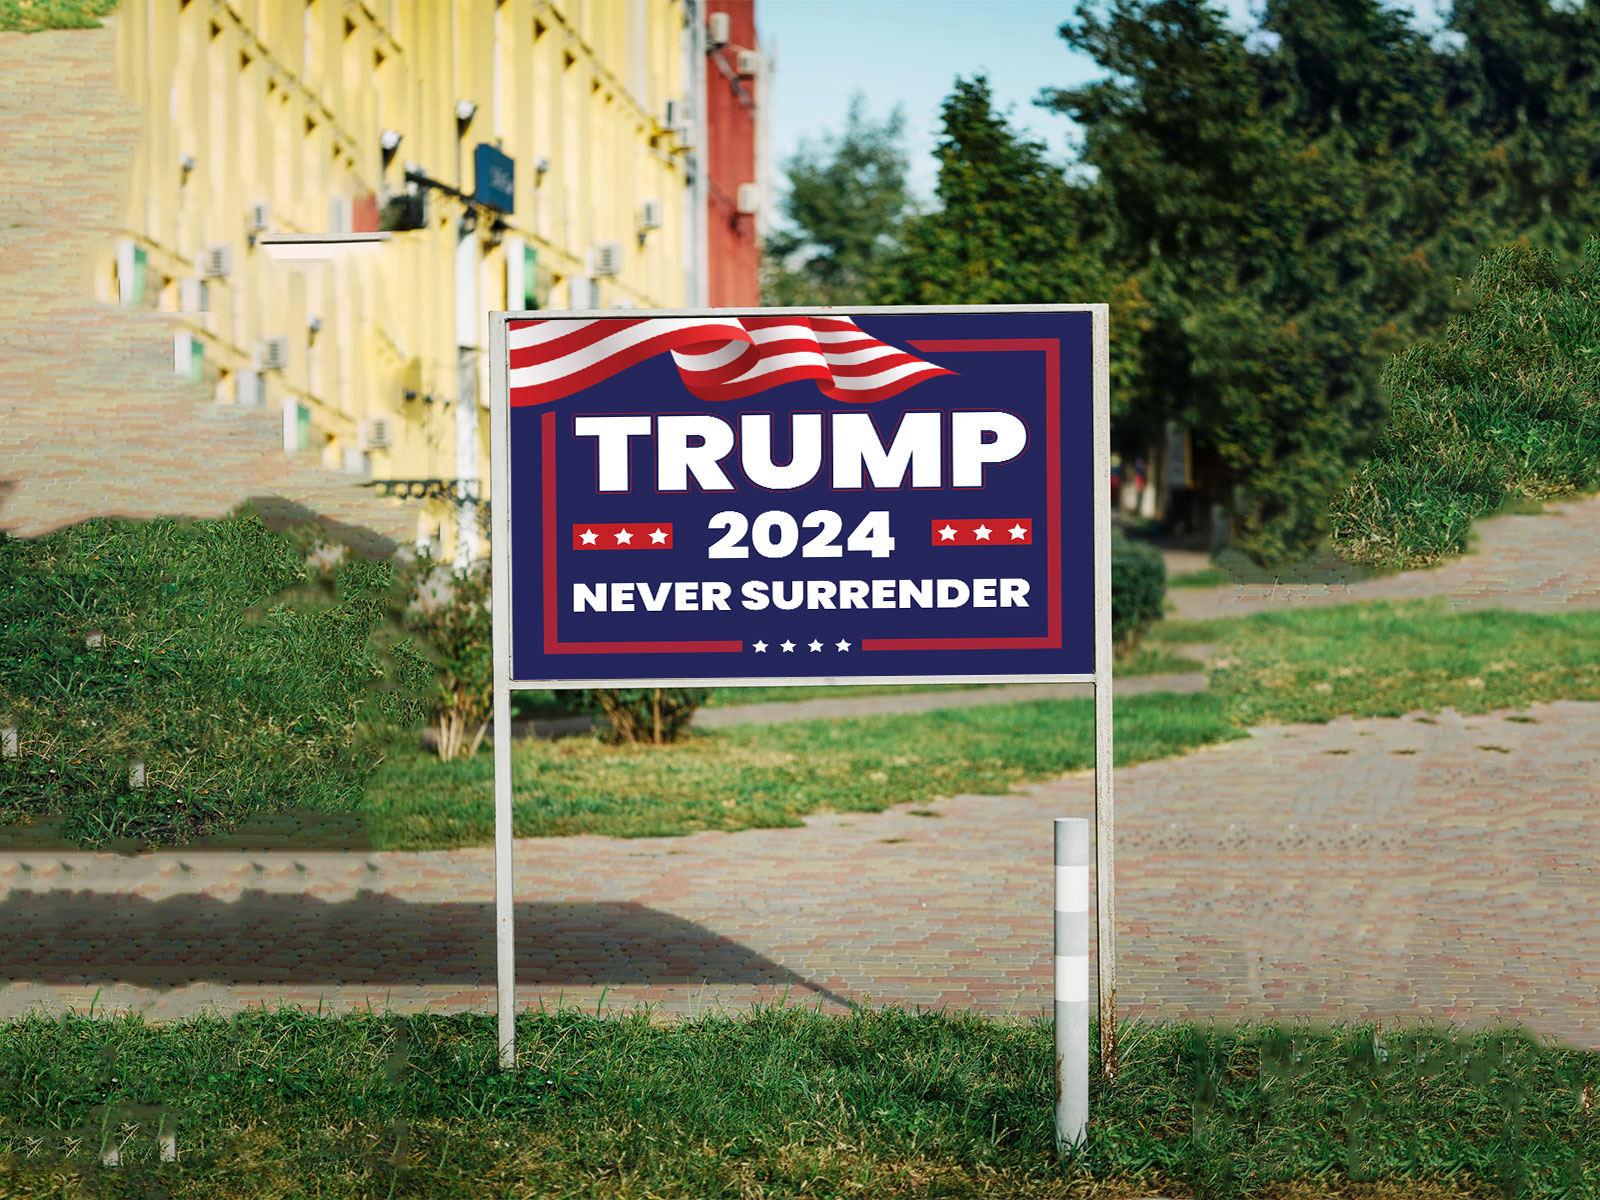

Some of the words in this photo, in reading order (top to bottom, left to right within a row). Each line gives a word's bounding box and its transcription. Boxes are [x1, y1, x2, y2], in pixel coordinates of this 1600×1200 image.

[575, 411, 1028, 492] TRUMP
[708, 510, 895, 559] 2024
[573, 582, 732, 613] NEVER
[742, 578, 1030, 611] SURRENDER
